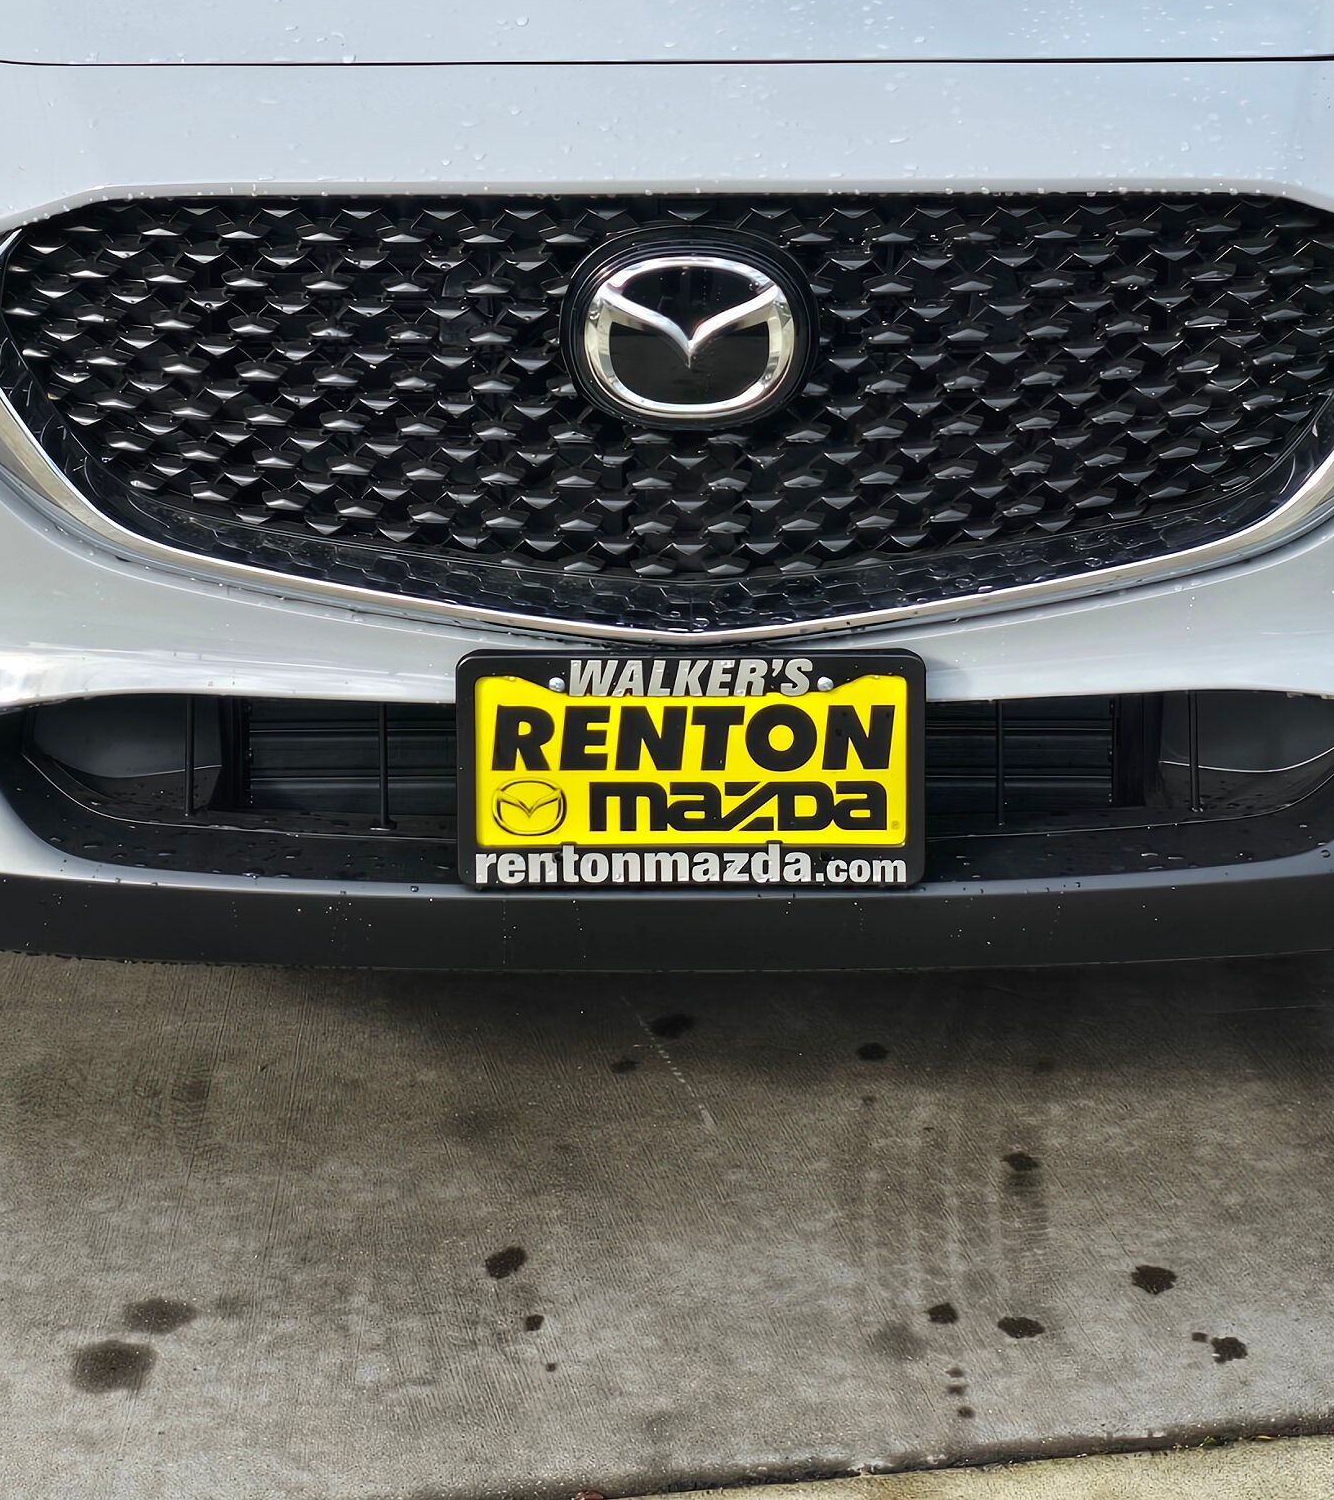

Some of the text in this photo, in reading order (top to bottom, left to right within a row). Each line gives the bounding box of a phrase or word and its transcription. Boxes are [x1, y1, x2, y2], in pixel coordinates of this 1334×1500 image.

[568, 658, 814, 697] WALKER'S
[491, 703, 896, 772] RENTON
[589, 780, 888, 832] mazda
[475, 843, 907, 884] rentonmazda.com
